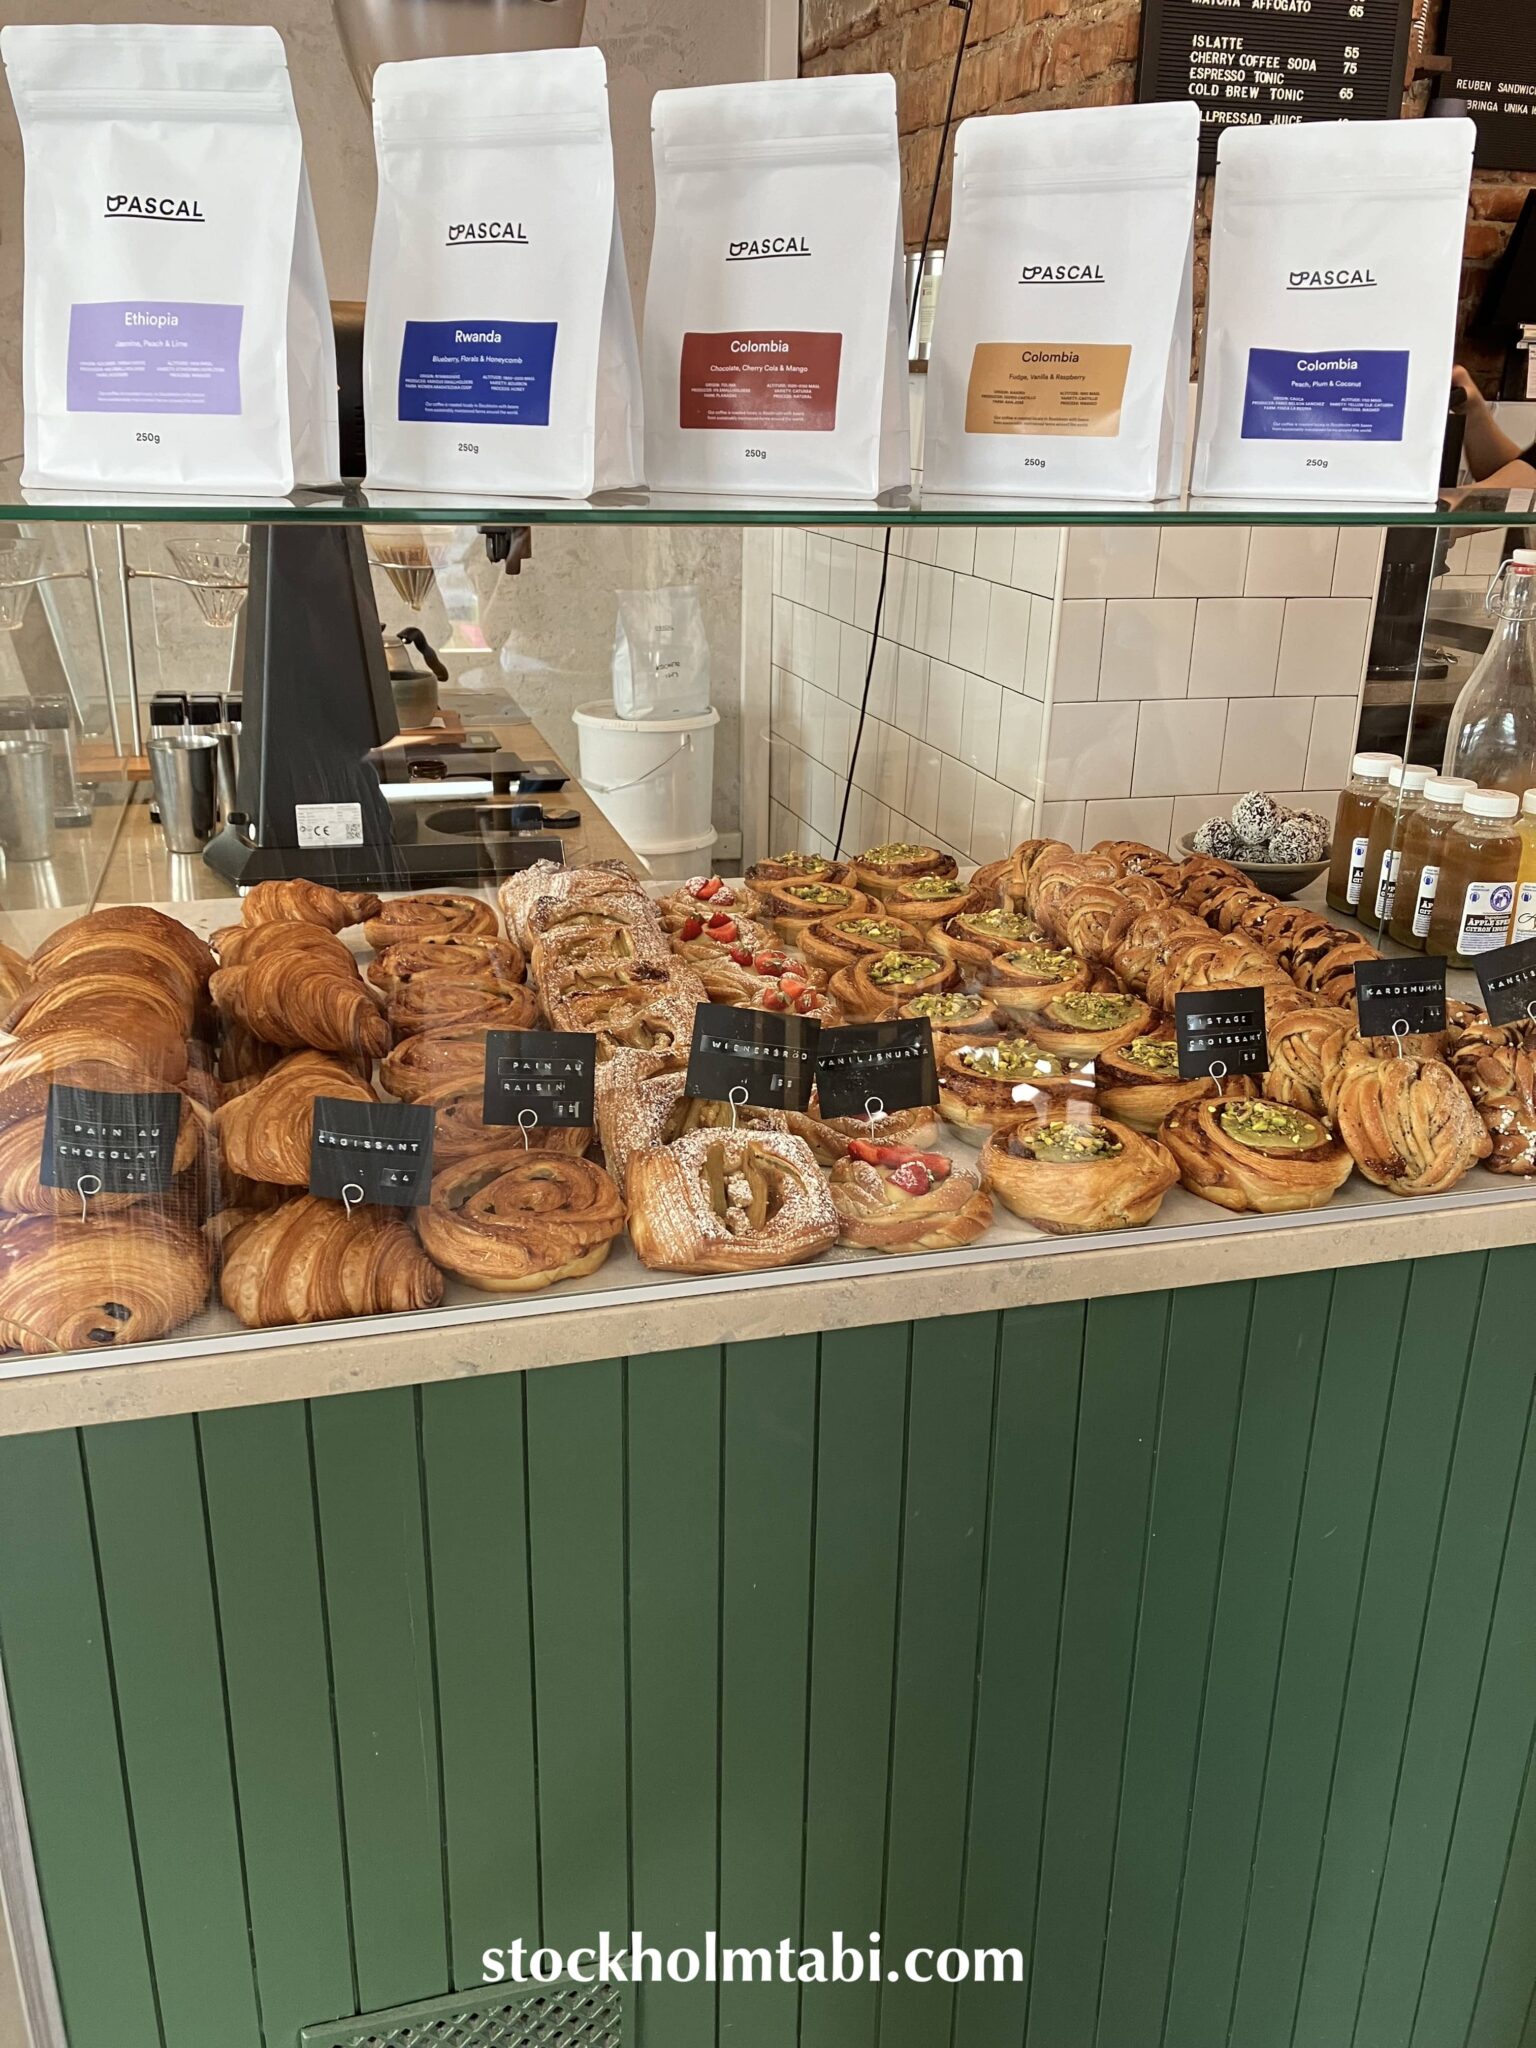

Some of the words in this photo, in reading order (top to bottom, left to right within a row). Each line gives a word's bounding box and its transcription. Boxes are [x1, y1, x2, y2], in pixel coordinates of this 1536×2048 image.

[1252, 0, 1311, 12] AFFOGATO
[1349, 6, 1364, 18] 65
[1192, 35, 1244, 50] ISLATTE
[1344, 46, 1360, 59] 55
[1189, 51, 1236, 65] CHERRY
[1239, 54, 1281, 69] COFFEE
[1287, 57, 1317, 72] SODA
[1343, 62, 1358, 75] 75
[1189, 68, 1246, 82] ESPRESSO
[1253, 71, 1285, 85] TONIC
[1188, 83, 1220, 97] COLD
[1225, 85, 1260, 100] BREW
[1269, 88, 1304, 101] TONIC
[1339, 87, 1354, 100] 65
[1456, 79, 1492, 92] REUBEN
[1503, 103, 1529, 115] UNIKA
[107, 195, 203, 217] PASCAL
[449, 222, 527, 241] PASCAL
[730, 237, 810, 257] PASCAL
[1022, 265, 1104, 281] PASCAL
[1290, 270, 1376, 286] PASCAL
[124, 311, 179, 328] Ethiopia
[455, 330, 502, 343] Rwanda
[730, 340, 790, 353] Colombia
[485, 356, 523, 365] Honeycomb
[1022, 351, 1080, 363] Colombia
[742, 365, 763, 374] Cherry
[785, 365, 808, 374] Mango
[1297, 358, 1358, 372] Colombia
[1008, 373, 1029, 381] Fudge,
[1055, 374, 1086, 382] Raspberry
[1291, 380, 1311, 388] Peach,
[1335, 380, 1362, 388] Coconut
[136, 432, 161, 444] 250g
[458, 442, 479, 454] 250g
[745, 448, 767, 459] 250g
[1024, 458, 1046, 469] 250g
[1306, 458, 1328, 469] 250g
[1189, 1033, 1262, 1047] CROISSANT
[818, 1048, 928, 1067] VANILJSNURRA
[564, 1063, 582, 1071] AU
[503, 1083, 563, 1091] RAISIN
[74, 1125, 122, 1136] PAIN
[138, 1128, 160, 1137] AU
[318, 1135, 419, 1152] CROISSANT
[59, 1145, 157, 1160] CHOCOLAT
[390, 1173, 409, 1182] 44
